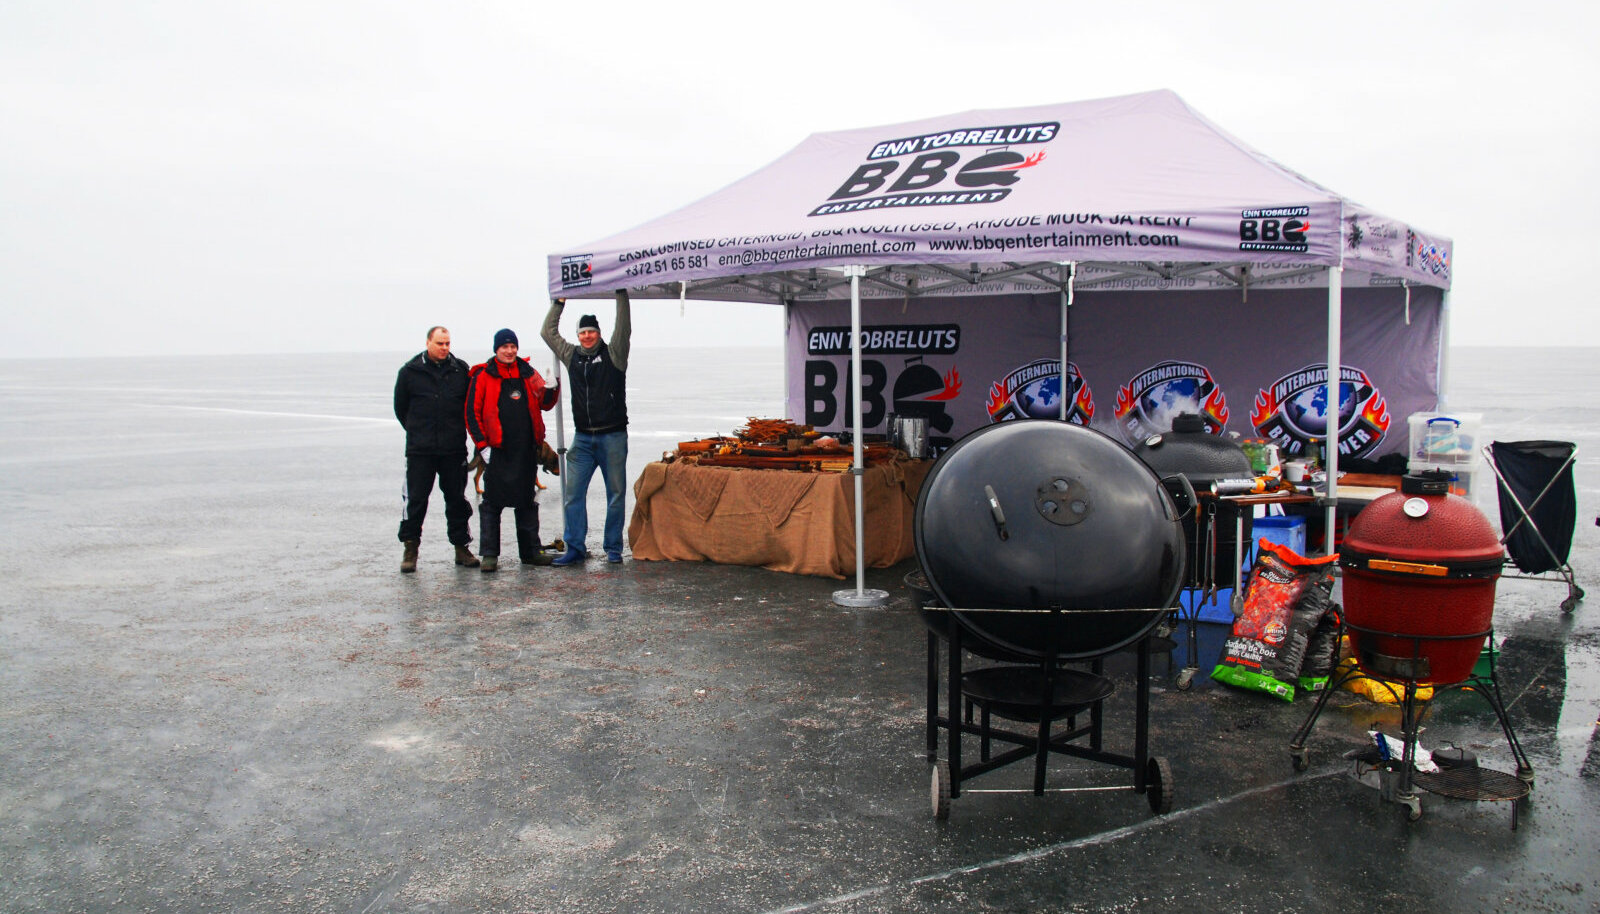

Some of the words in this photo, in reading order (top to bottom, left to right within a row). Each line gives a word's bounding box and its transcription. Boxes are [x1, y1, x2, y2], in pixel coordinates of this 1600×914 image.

[870, 140, 917, 159] ENN
[921, 125, 1056, 150] TOBRELUTS
[827, 146, 1026, 201] BBQ
[816, 192, 1003, 214] ENTERTAINMENT
[1243, 209, 1260, 218] ENN
[1261, 207, 1308, 217] TOBRELUTS
[1240, 217, 1307, 242] BBQ
[625, 263, 652, 277] +372
[655, 260, 667, 272] 51
[671, 259, 685, 270] 65
[688, 255, 709, 268] 581
[718, 240, 916, 266] enn@bbqentertainment.com
[929, 231, 1179, 252] www.bbqentertainment.com
[1241, 243, 1306, 252] ENTERTAINMENT
[561, 263, 593, 281] BBQ
[809, 331, 842, 350] ENN
[1132, 365, 1206, 399] INTERNATIONAL
[1260, 646, 1277, 658] bois
